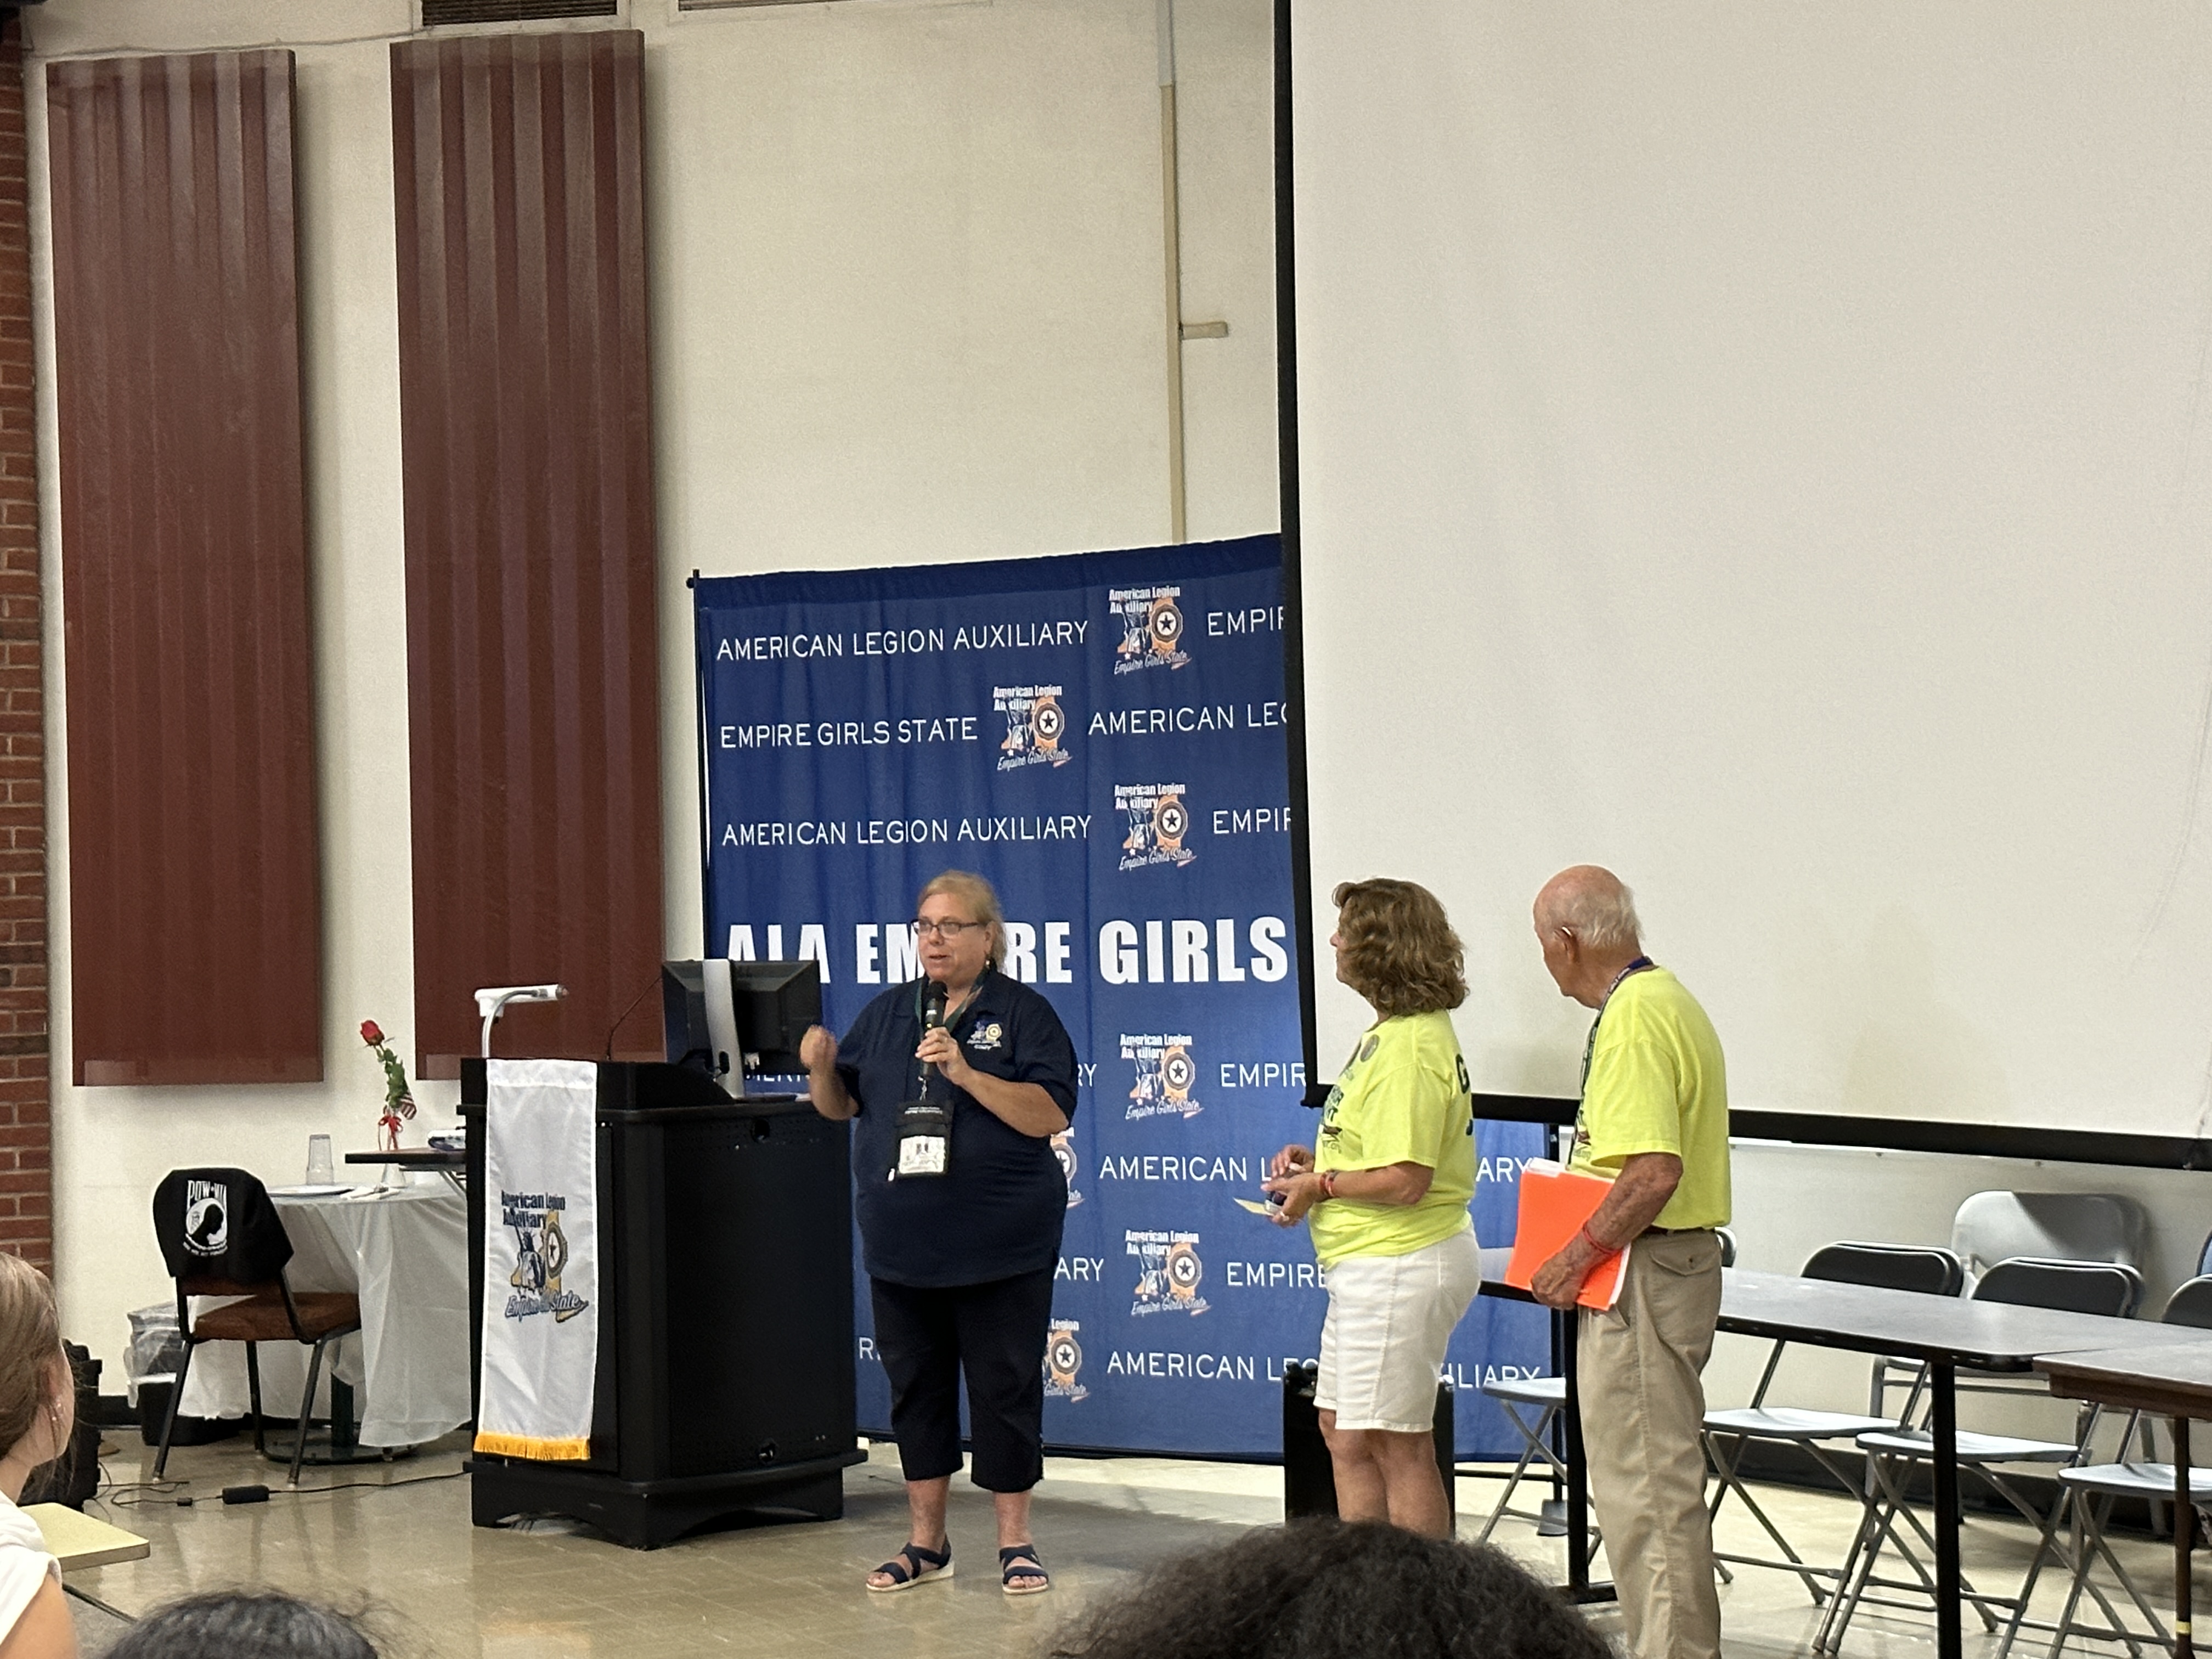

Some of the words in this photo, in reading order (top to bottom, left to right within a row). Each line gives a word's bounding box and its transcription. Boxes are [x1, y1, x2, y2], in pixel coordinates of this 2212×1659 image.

[717, 634, 842, 660] AMERICAN
[854, 629, 943, 655] LEGION
[954, 621, 1087, 650] AUXILIARY
[721, 724, 811, 748] EMPIRE
[818, 721, 889, 745] GIRLS
[898, 718, 977, 743] STATE
[1089, 705, 1233, 735] AMERICAN
[1248, 702, 1286, 726] LE
[723, 822, 845, 845] AMERICAN
[857, 819, 947, 843] LEGION
[957, 815, 1091, 840] AUXILIARY
[856, 922, 1072, 983] EMRE
[1099, 917, 1288, 984] GIRLS
[1099, 1156, 1247, 1181] AMERICAN
[1108, 1351, 1254, 1380] AMERICAN
